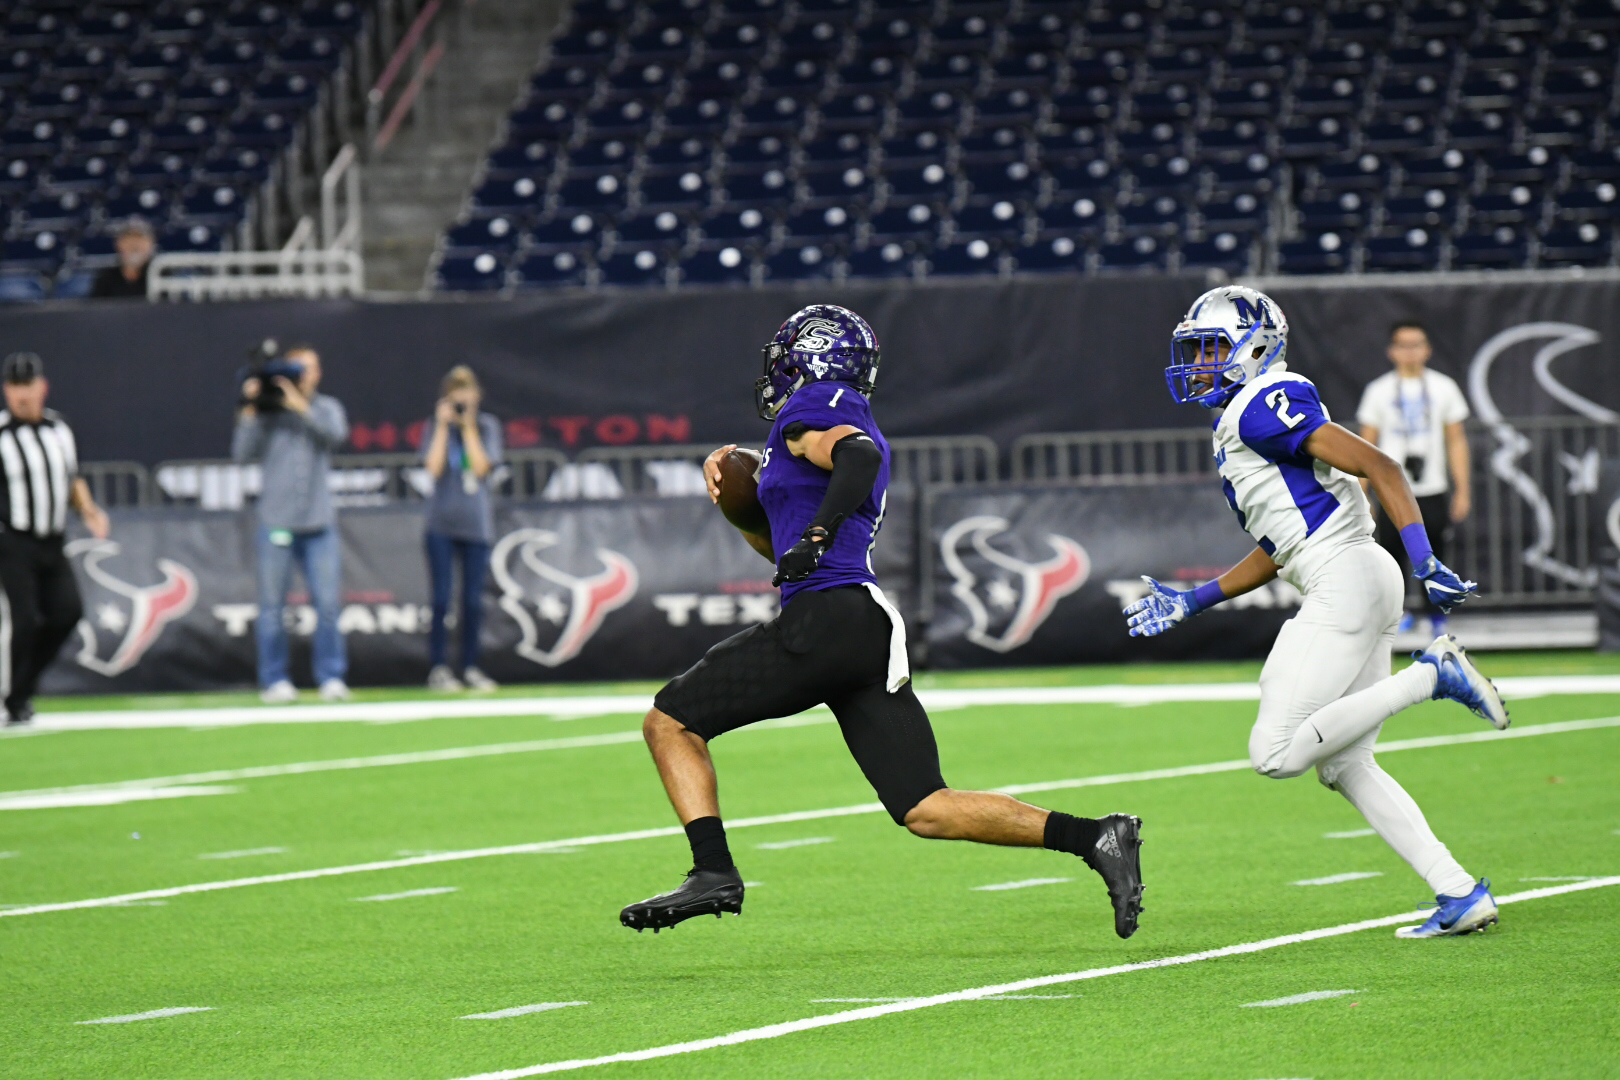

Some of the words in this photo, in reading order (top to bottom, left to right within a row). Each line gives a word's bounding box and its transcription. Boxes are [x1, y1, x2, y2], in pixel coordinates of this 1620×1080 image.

[1228, 295, 1277, 331] M
[828, 388, 845, 408] 1
[1264, 387, 1307, 430] 2
[351, 414, 691, 449] HSTON
[654, 594, 784, 627] TEX
[1107, 826, 1122, 858] adidas
